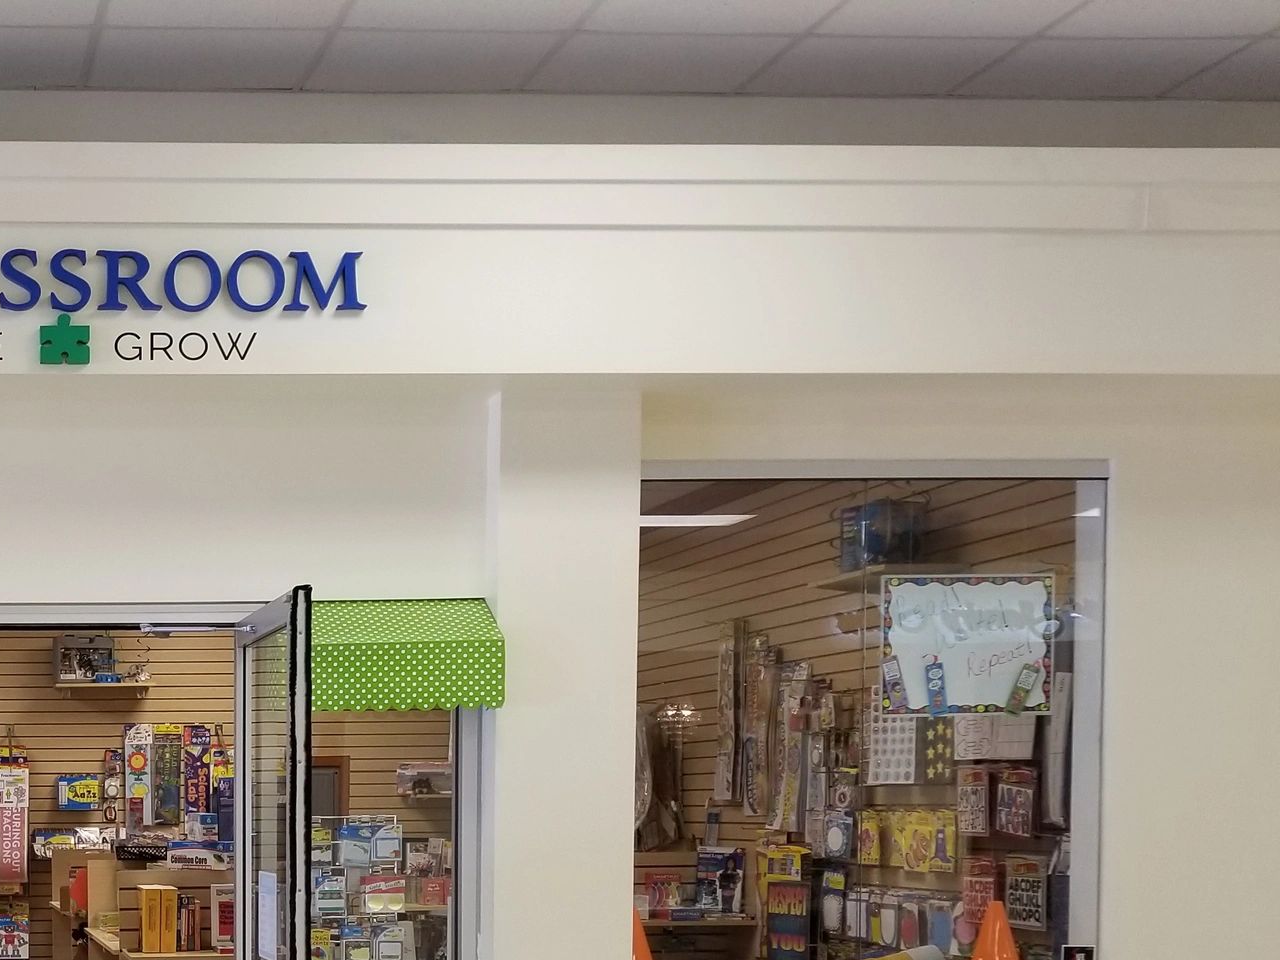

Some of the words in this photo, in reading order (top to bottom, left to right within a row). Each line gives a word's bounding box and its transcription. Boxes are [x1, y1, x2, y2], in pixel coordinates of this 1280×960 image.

[114, 331, 258, 361] GROW
[187, 779, 199, 802] Lab
[3, 807, 12, 865] FRACTIONS
[12, 807, 21, 849] GURING
[12, 850, 21, 873] OUT
[1008, 879, 1042, 892] ABCDEF
[1008, 894, 1041, 907] GHIJKL
[771, 933, 806, 952] YOU
